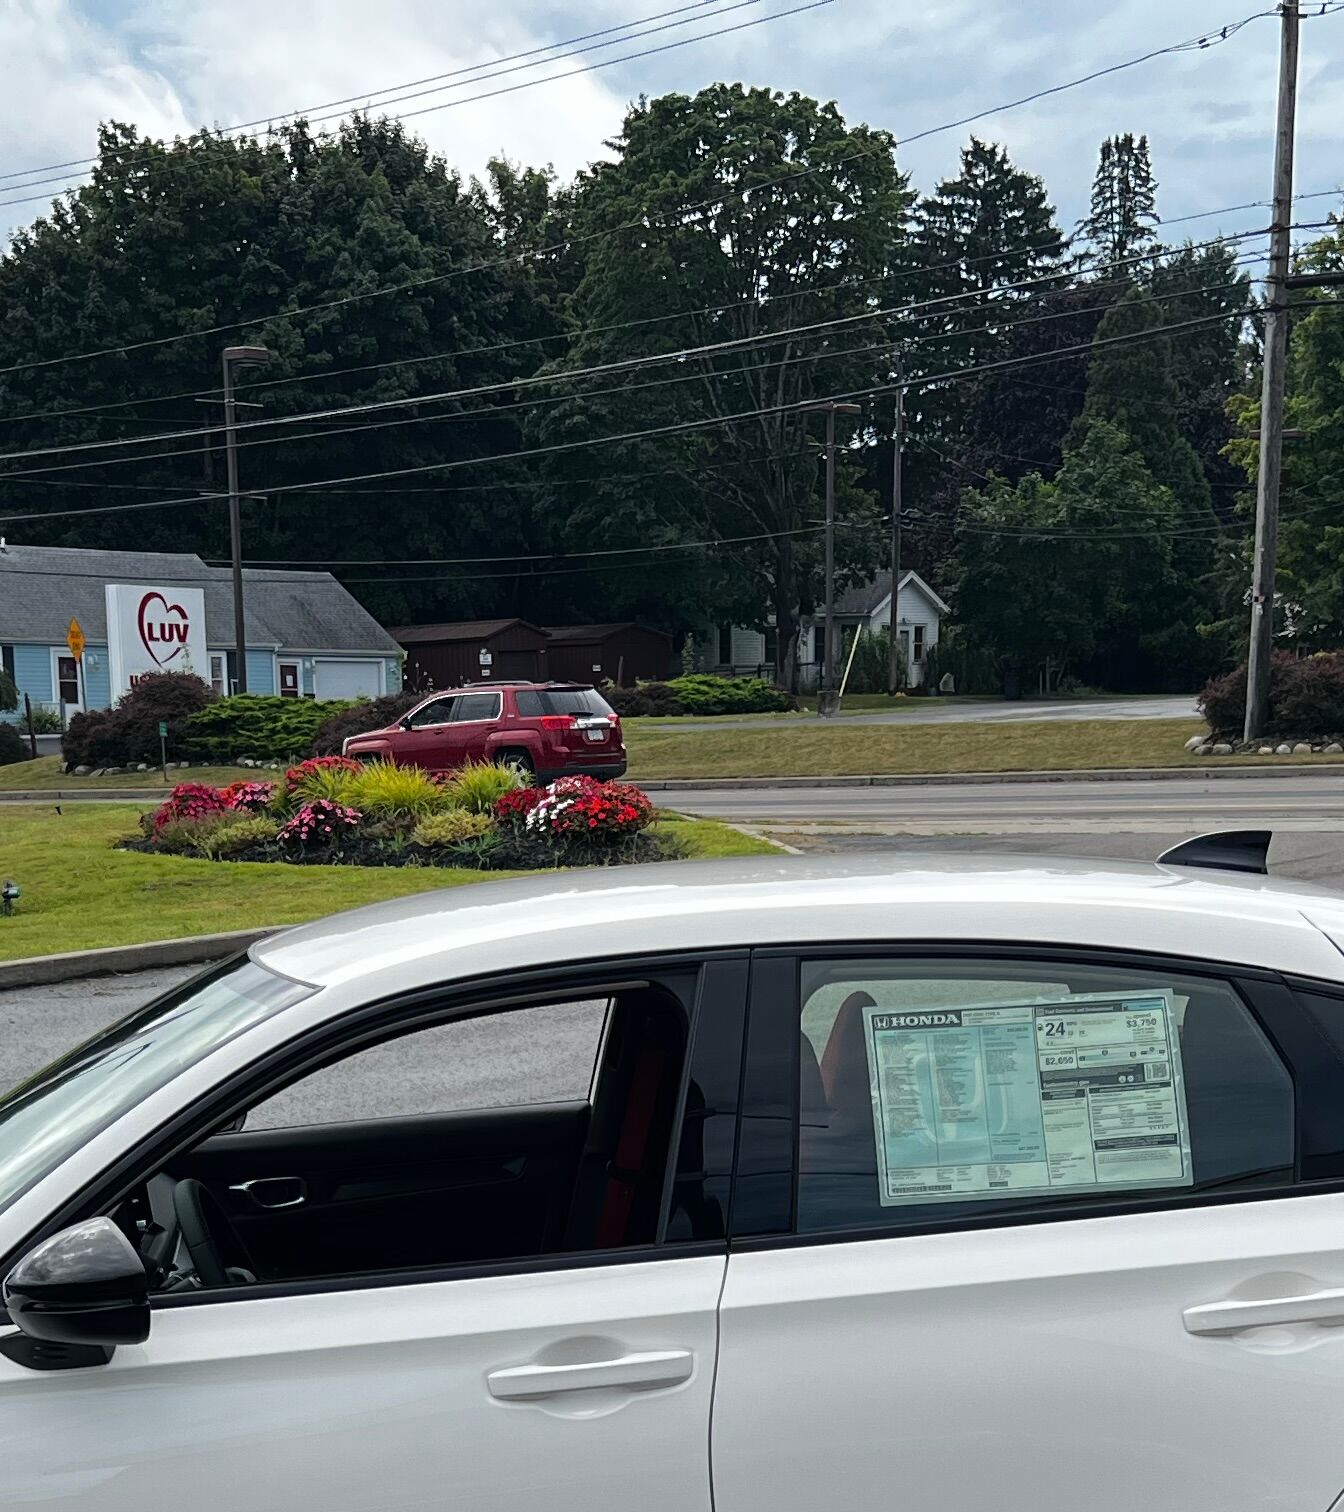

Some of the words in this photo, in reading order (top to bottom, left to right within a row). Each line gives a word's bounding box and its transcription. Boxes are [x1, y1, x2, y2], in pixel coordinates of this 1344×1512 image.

[147, 622, 189, 643] LUV
[890, 1014, 960, 1027] HONDA
[1045, 1021, 1065, 1037] 24
